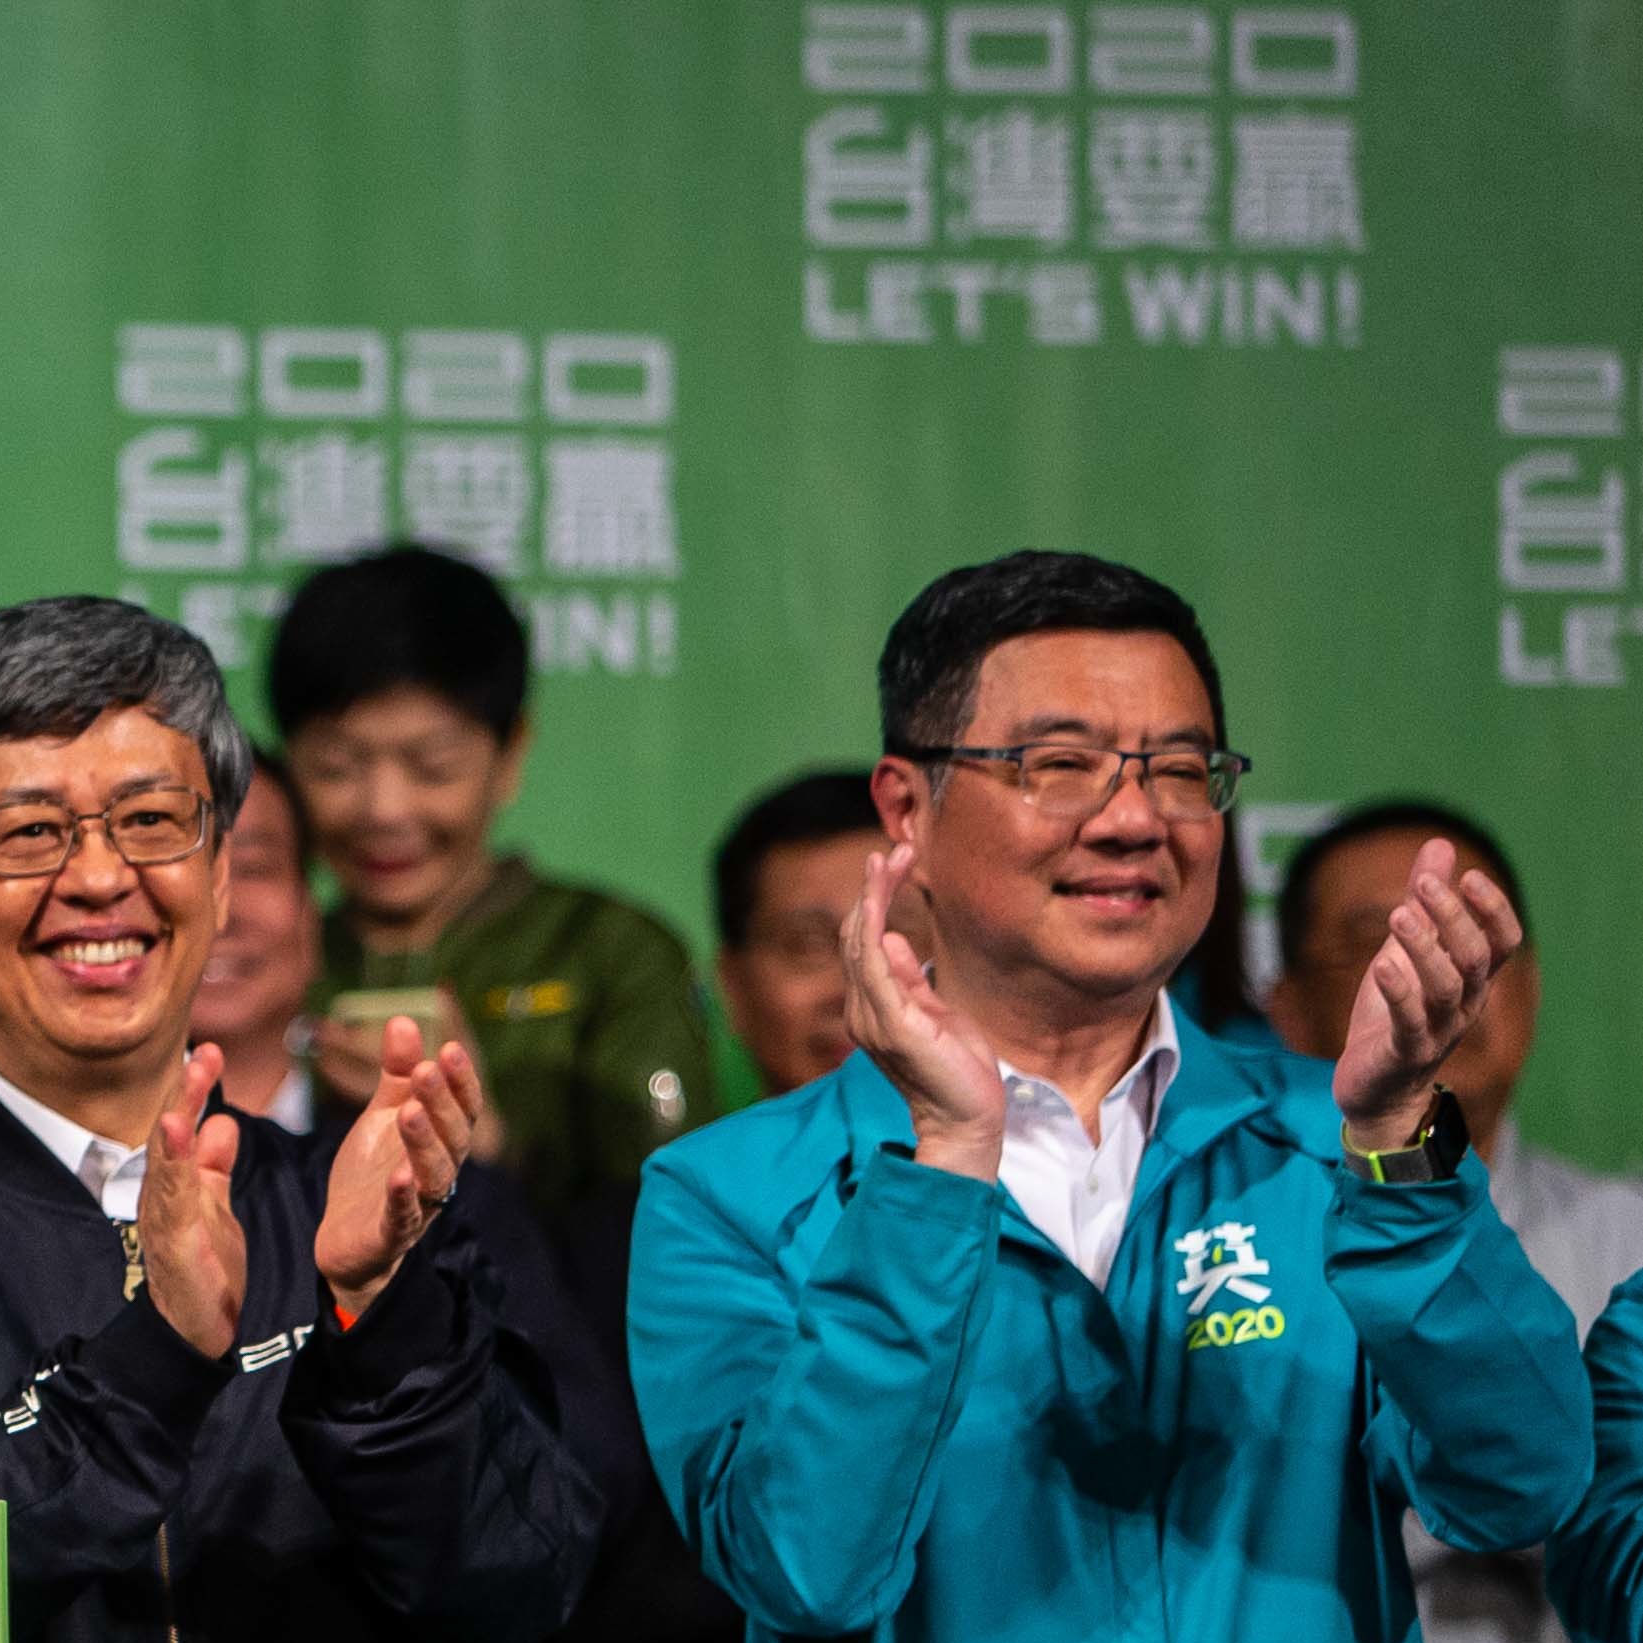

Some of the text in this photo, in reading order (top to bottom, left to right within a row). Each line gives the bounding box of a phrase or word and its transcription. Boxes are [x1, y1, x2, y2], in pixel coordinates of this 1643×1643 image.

[804, 5, 1356, 94] 2020
[1124, 262, 1360, 348] WIN!
[118, 322, 674, 424] 2020
[1174, 1221, 1272, 1315] 英
[1186, 1305, 1284, 1350] 2020
